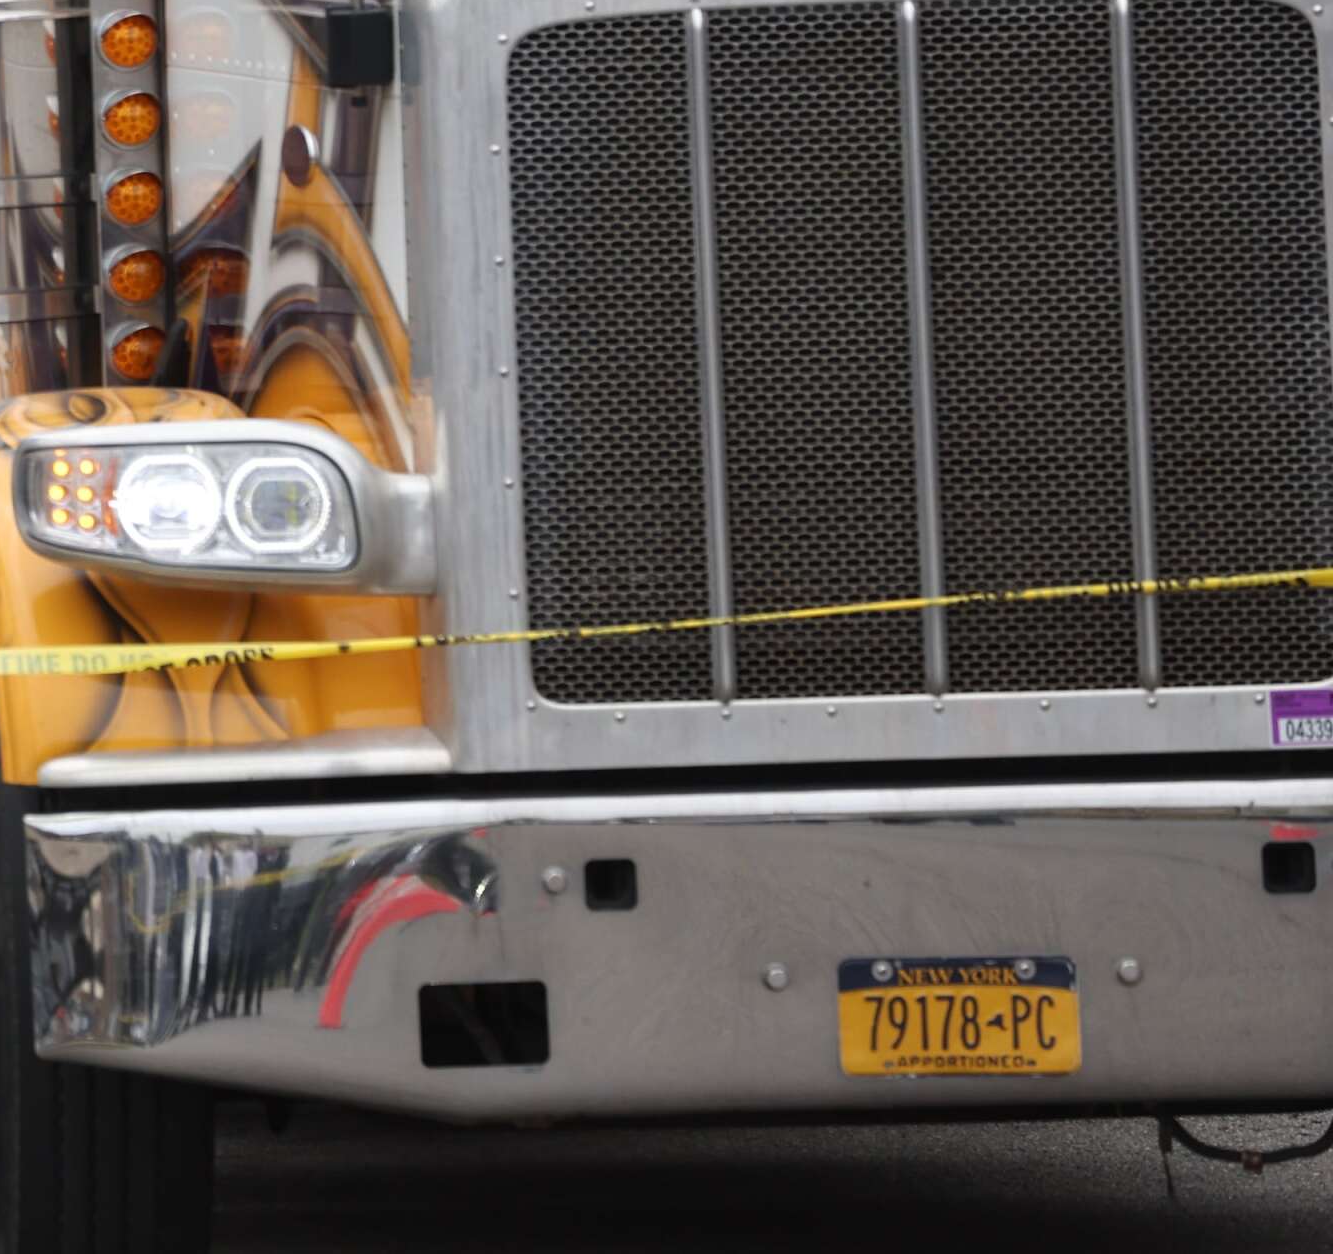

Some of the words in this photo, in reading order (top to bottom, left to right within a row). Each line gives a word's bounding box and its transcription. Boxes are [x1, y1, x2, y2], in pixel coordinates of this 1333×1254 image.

[898, 967, 954, 986] NEW
[958, 966, 1021, 986] YORK
[864, 995, 981, 1052] 79178
[1010, 995, 1057, 1051] PC
[898, 1054, 1025, 1069] APPORTIONED
